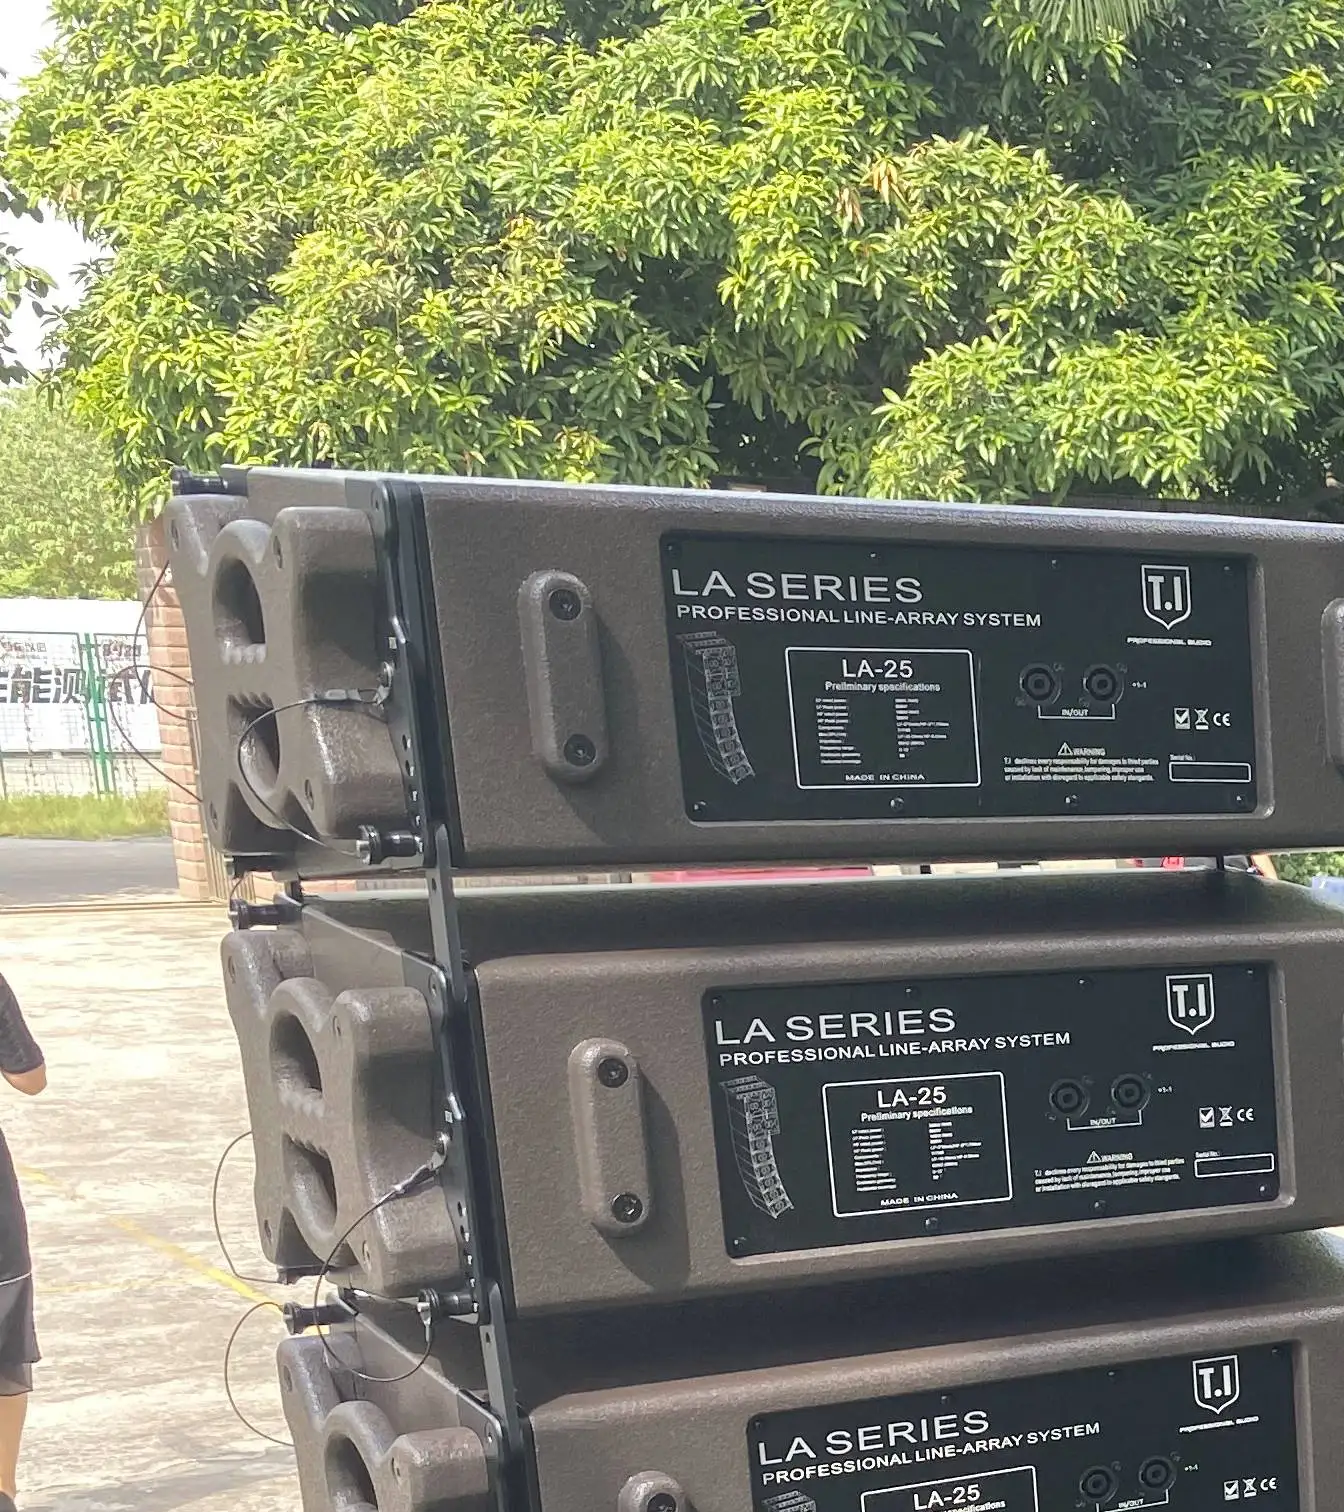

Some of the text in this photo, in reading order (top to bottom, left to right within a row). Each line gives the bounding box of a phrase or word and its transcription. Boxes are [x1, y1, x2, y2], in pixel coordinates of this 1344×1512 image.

[672, 568, 923, 604] LA SERIES
[677, 604, 1042, 628] PROFESSIONAL LINE-ARRAY SYSTEM
[841, 658, 914, 679] LA-25
[824, 680, 941, 694] Preliminary specifications
[844, 773, 926, 782] MADE IN CHINA
[715, 1007, 956, 1046] LA SERIES
[719, 1031, 1071, 1067] PROFESSIONAL LINE-ARRAY SYSTEM
[877, 1085, 947, 1109] LA-25
[860, 1105, 974, 1123] Preliminary specifications
[879, 1192, 959, 1207] MADE IN CHINA
[757, 1410, 990, 1466] LA SERIES
[761, 1421, 1100, 1486] PROFESSIONAL LINE-ARRAY SYSTEM
[913, 1483, 981, 1511] LA-25
